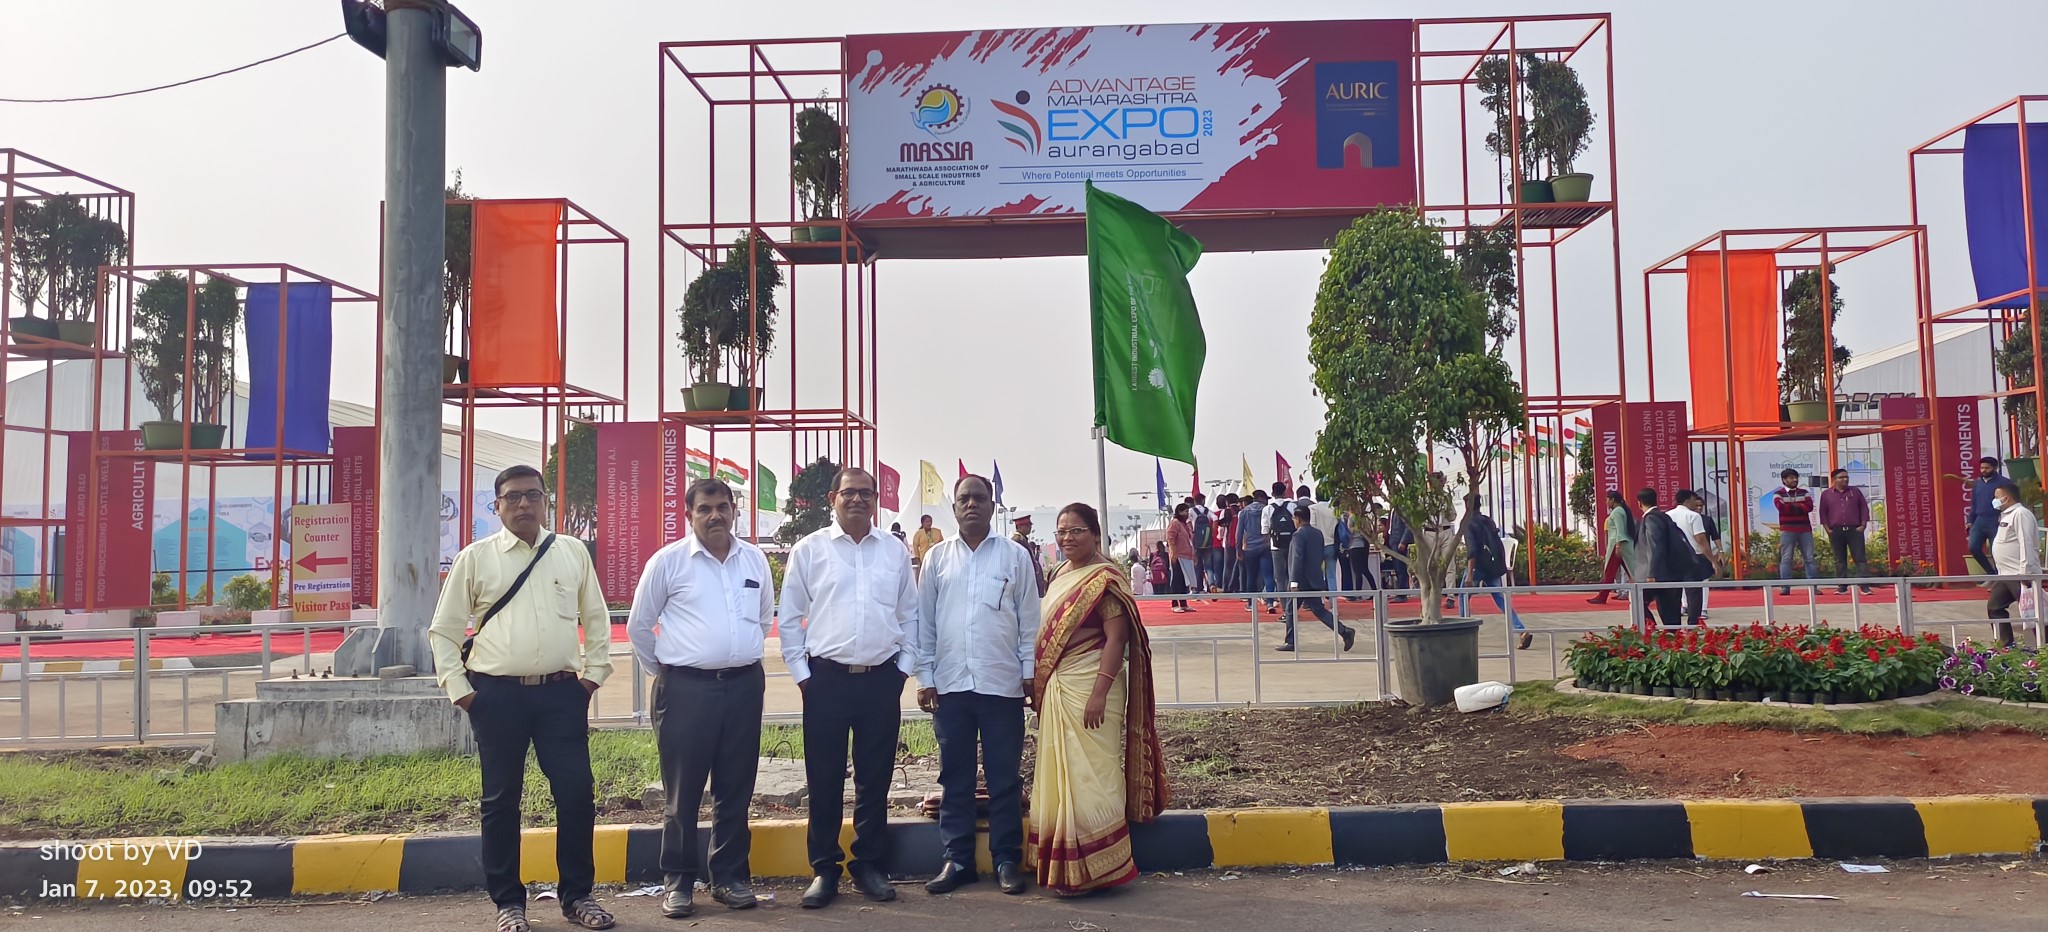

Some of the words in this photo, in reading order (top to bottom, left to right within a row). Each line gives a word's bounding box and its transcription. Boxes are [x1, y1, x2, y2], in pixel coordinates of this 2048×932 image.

[1048, 76, 1196, 94] ADVANTAGE
[1048, 92, 1198, 106] MAHARASHTRA
[1326, 82, 1388, 100] AURIC
[1048, 106, 1199, 141] EXPO
[1203, 110, 1212, 136] 2023
[900, 141, 974, 162] MASSIA
[1048, 138, 1200, 160] aurangabad
[1022, 171, 1052, 180] Where
[1054, 170, 1094, 179] Potential
[1096, 170, 1124, 178] meets
[1126, 168, 1186, 179] Opportunities
[1643, 410, 1652, 432] INKS
[1655, 410, 1666, 450] CUTTERS
[1667, 410, 1676, 433] NUTS
[1916, 404, 1926, 435] BKES
[101, 436, 109, 482] WELLESS
[664, 429, 677, 496] MACHINES
[1644, 439, 1654, 473] PAPERS
[1669, 444, 1679, 471] BOLTS
[1905, 427, 1915, 469] ELECTRICA
[1918, 442, 1929, 485] BATTERIES
[78, 474, 86, 492] R&D
[342, 457, 351, 501] MACHINES
[354, 475, 362, 500] DRILL
[607, 468, 616, 510] LEARNING
[631, 460, 639, 518] PROGAMMING
[1603, 431, 1618, 514] INDUSTR
[1657, 457, 1668, 502] GRINDERS
[1894, 466, 1904, 512] STAMPINGS
[77, 494, 85, 517] AGRO
[100, 485, 108, 515] CATTLE
[365, 489, 373, 528] ROUTERS
[619, 480, 628, 536] TECHNOLOGY
[664, 500, 677, 508] &
[1907, 476, 1918, 526] ASSEMBLIES
[1920, 492, 1931, 523] CLUTCH
[294, 516, 349, 528] Registration
[304, 533, 340, 543] Counter
[353, 508, 362, 551] GRINDERS
[607, 512, 616, 546] MACHIN
[1899, 522, 1908, 553] METALS
[76, 524, 85, 578] PROCESSING
[98, 523, 107, 576] PROCESSING
[364, 536, 372, 569] PAPERS
[631, 526, 639, 572] ANALYTICS
[1909, 528, 1921, 566] RICATION
[1924, 530, 1934, 564] EMBLEIS
[353, 558, 361, 597] CUTTERS
[607, 554, 616, 596] ROBOTICS
[619, 538, 628, 596] INFORMATION
[97, 579, 106, 602] FOOD
[308, 581, 350, 591] Registration
[364, 576, 372, 597] INKS
[295, 601, 328, 613] Visitor
[330, 600, 350, 610] Pass
